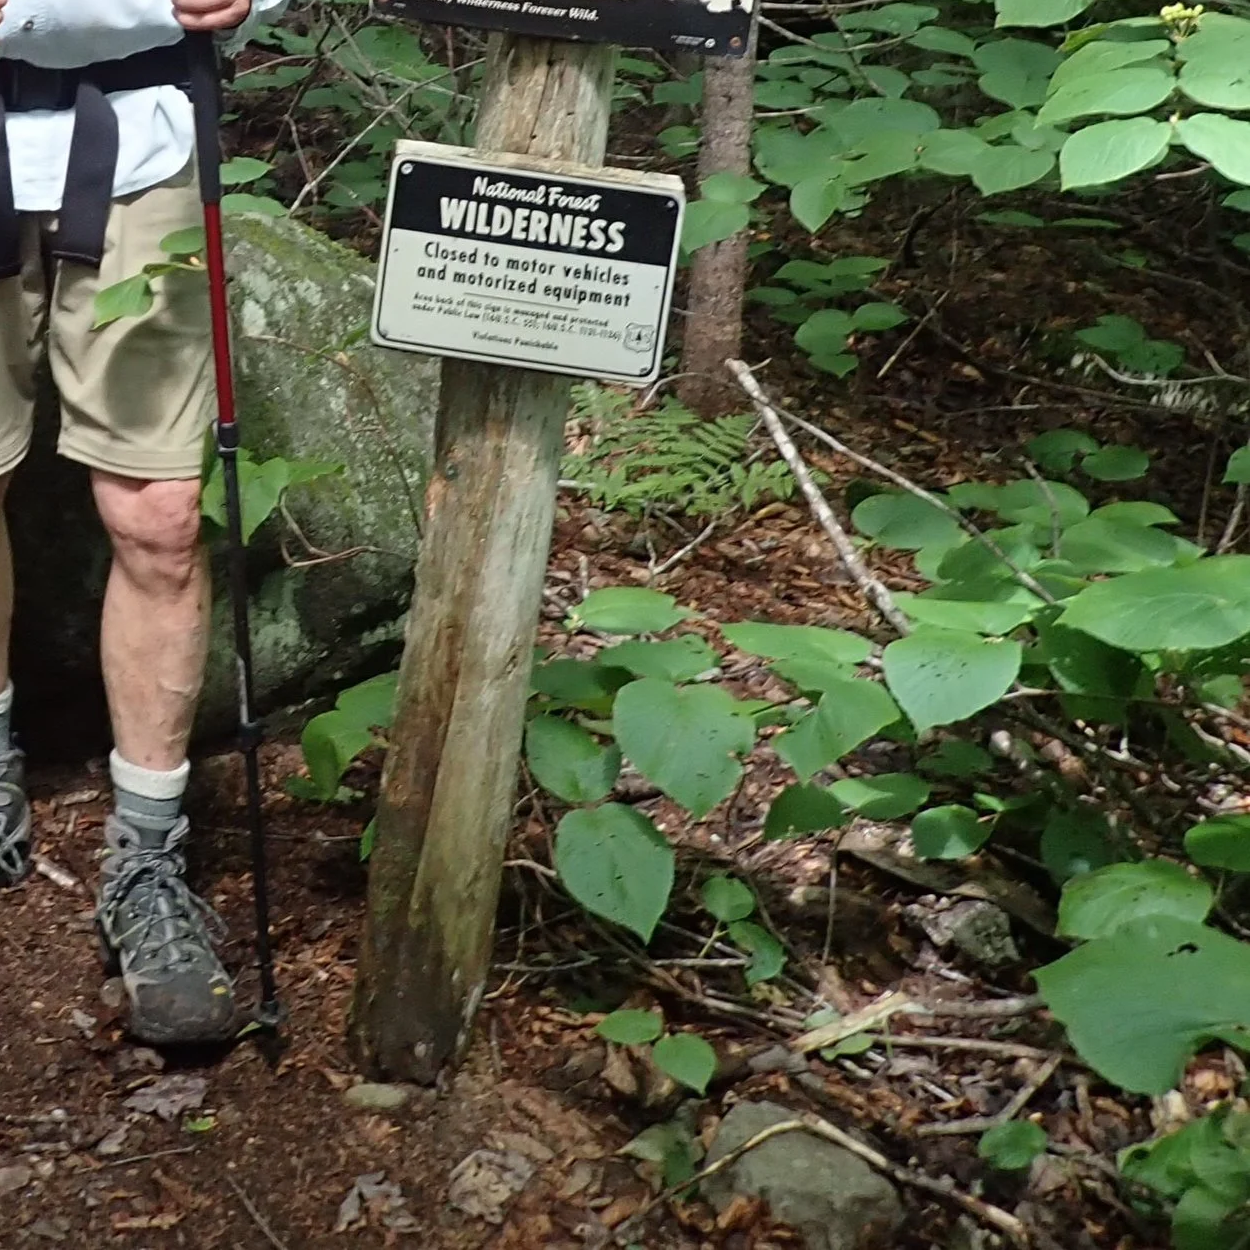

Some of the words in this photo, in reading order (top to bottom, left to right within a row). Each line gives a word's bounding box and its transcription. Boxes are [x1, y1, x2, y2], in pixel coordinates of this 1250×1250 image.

[472, 175, 546, 205] National
[547, 186, 601, 212] Forest
[440, 196, 626, 253] WILDERNESS
[416, 263, 447, 280] and
[452, 271, 537, 294] motorized
[543, 284, 630, 307] equipment
[424, 241, 478, 264] Closed
[483, 251, 499, 267] to
[505, 258, 555, 275] motor
[562, 263, 628, 285] vehicles
